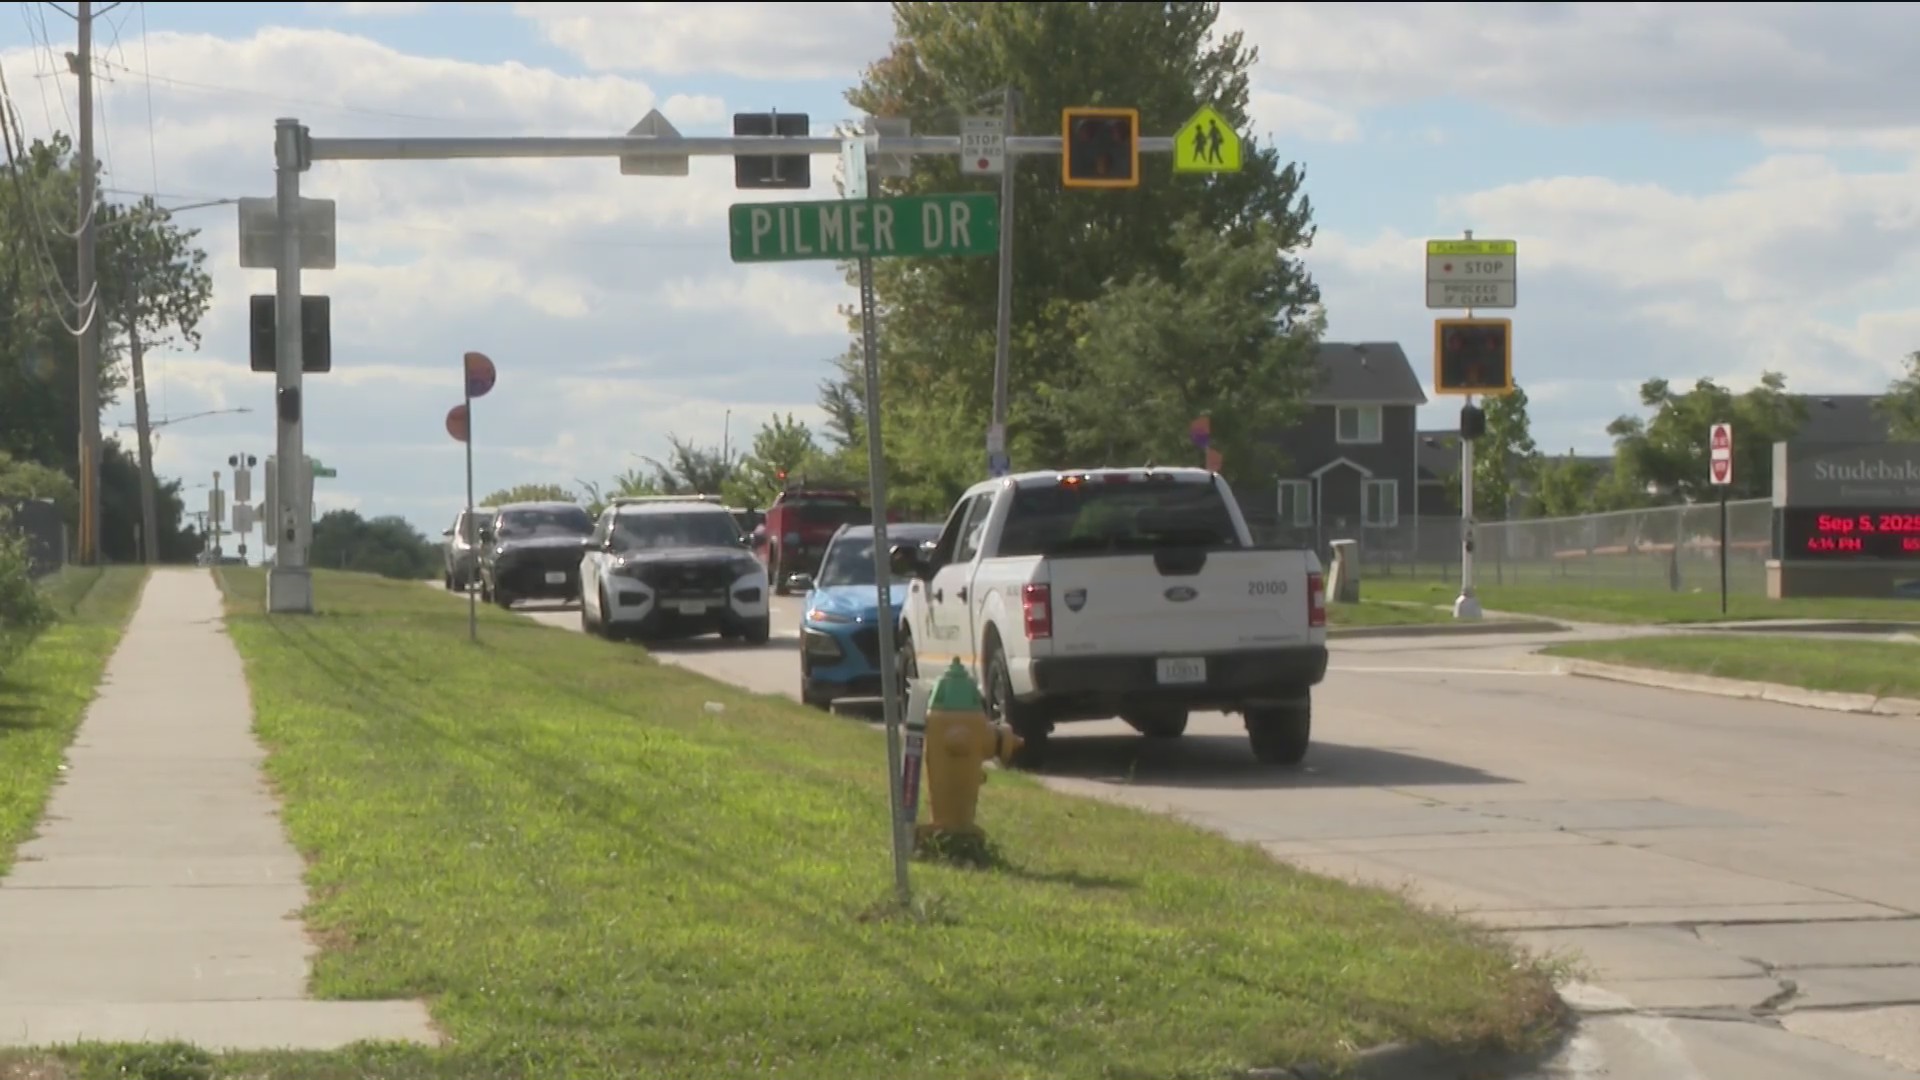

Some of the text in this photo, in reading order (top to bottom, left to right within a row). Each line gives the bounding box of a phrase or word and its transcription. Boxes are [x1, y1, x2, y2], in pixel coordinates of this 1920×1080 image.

[967, 134, 999, 146] STOP
[750, 201, 974, 255] PILMER DR
[1464, 261, 1504, 274] STOP
[1444, 285, 1498, 294] PROCEED
[1460, 295, 1498, 304] CLEAR
[1815, 459, 1920, 480] Studebak
[1818, 514, 1853, 532] Sep
[1859, 514, 1874, 531] 5,
[1838, 538, 1862, 550] PM
[1247, 580, 1288, 595] 20100
